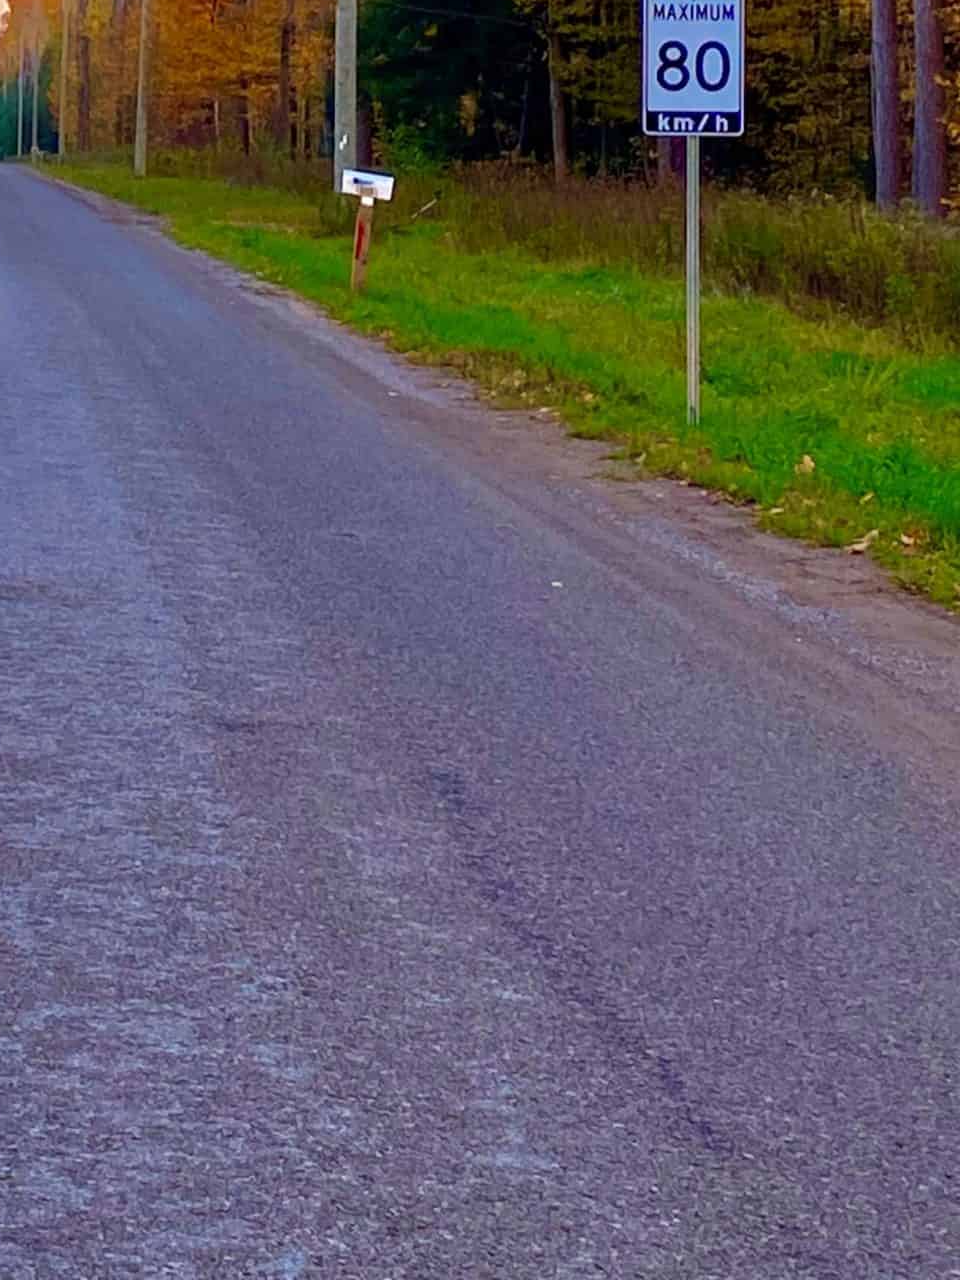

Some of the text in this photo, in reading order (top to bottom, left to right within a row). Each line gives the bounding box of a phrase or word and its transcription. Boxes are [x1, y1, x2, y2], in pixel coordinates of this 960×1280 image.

[653, 3, 735, 21] MAXIMUM
[656, 40, 731, 92] 80
[657, 113, 729, 132] km/h
